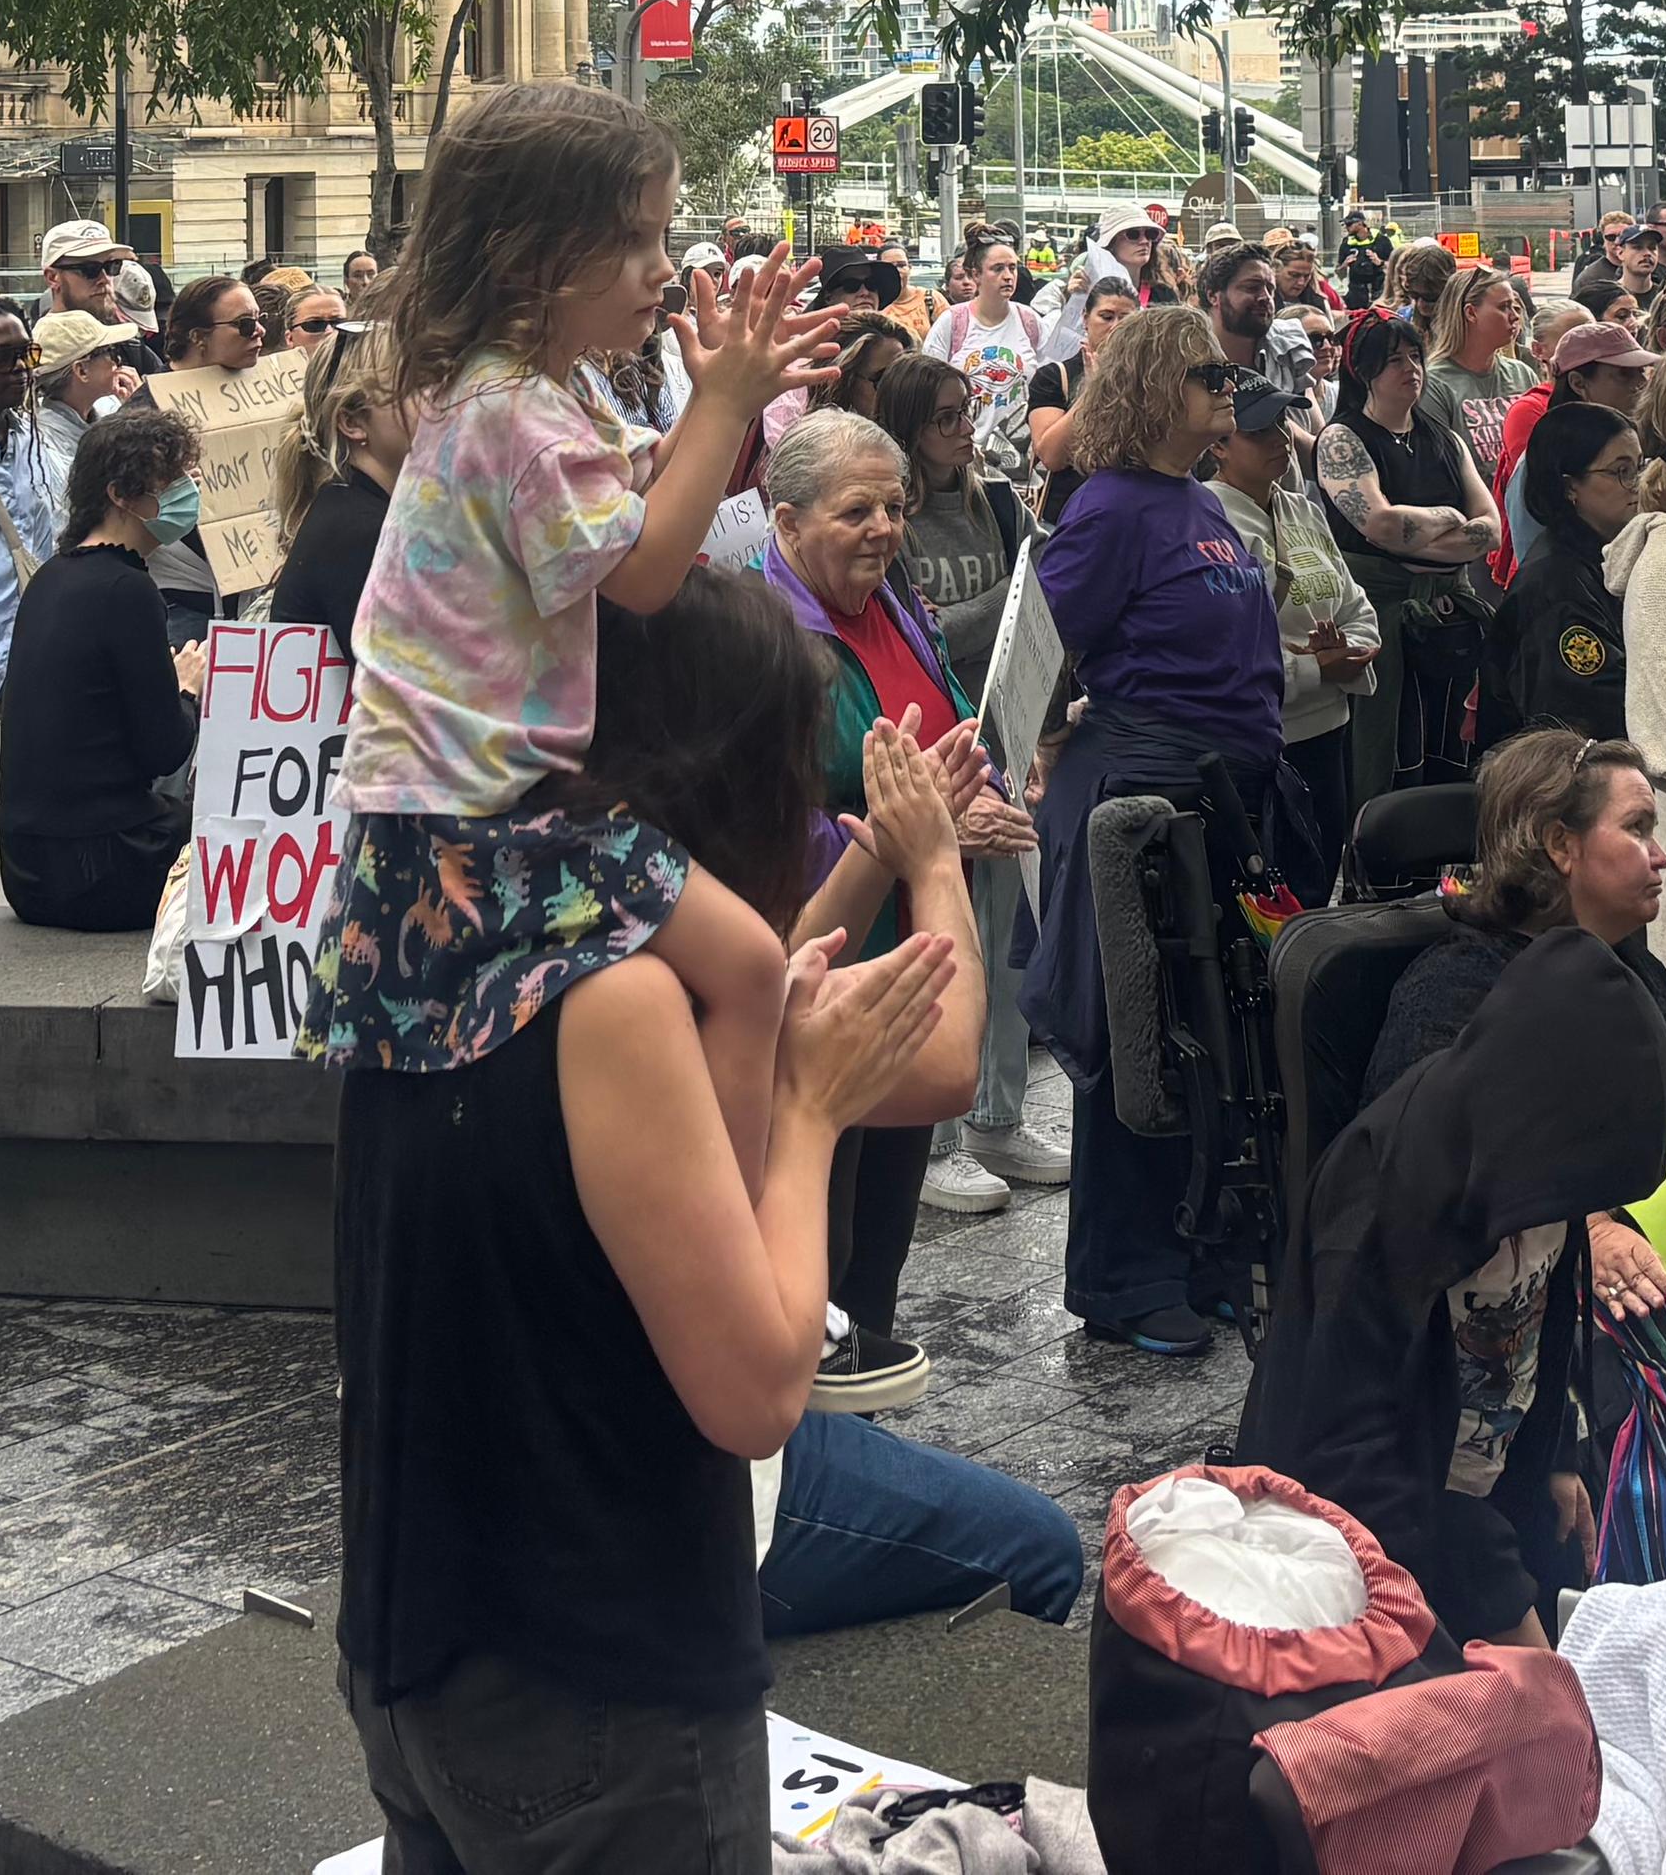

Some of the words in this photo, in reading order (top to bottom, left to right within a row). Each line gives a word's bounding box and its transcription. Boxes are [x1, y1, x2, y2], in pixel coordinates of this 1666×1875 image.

[813, 126, 833, 143] 20
[169, 389, 209, 422] MY
[220, 368, 304, 413] SILENCE
[198, 451, 250, 494] WONT
[203, 625, 352, 726] FIGH
